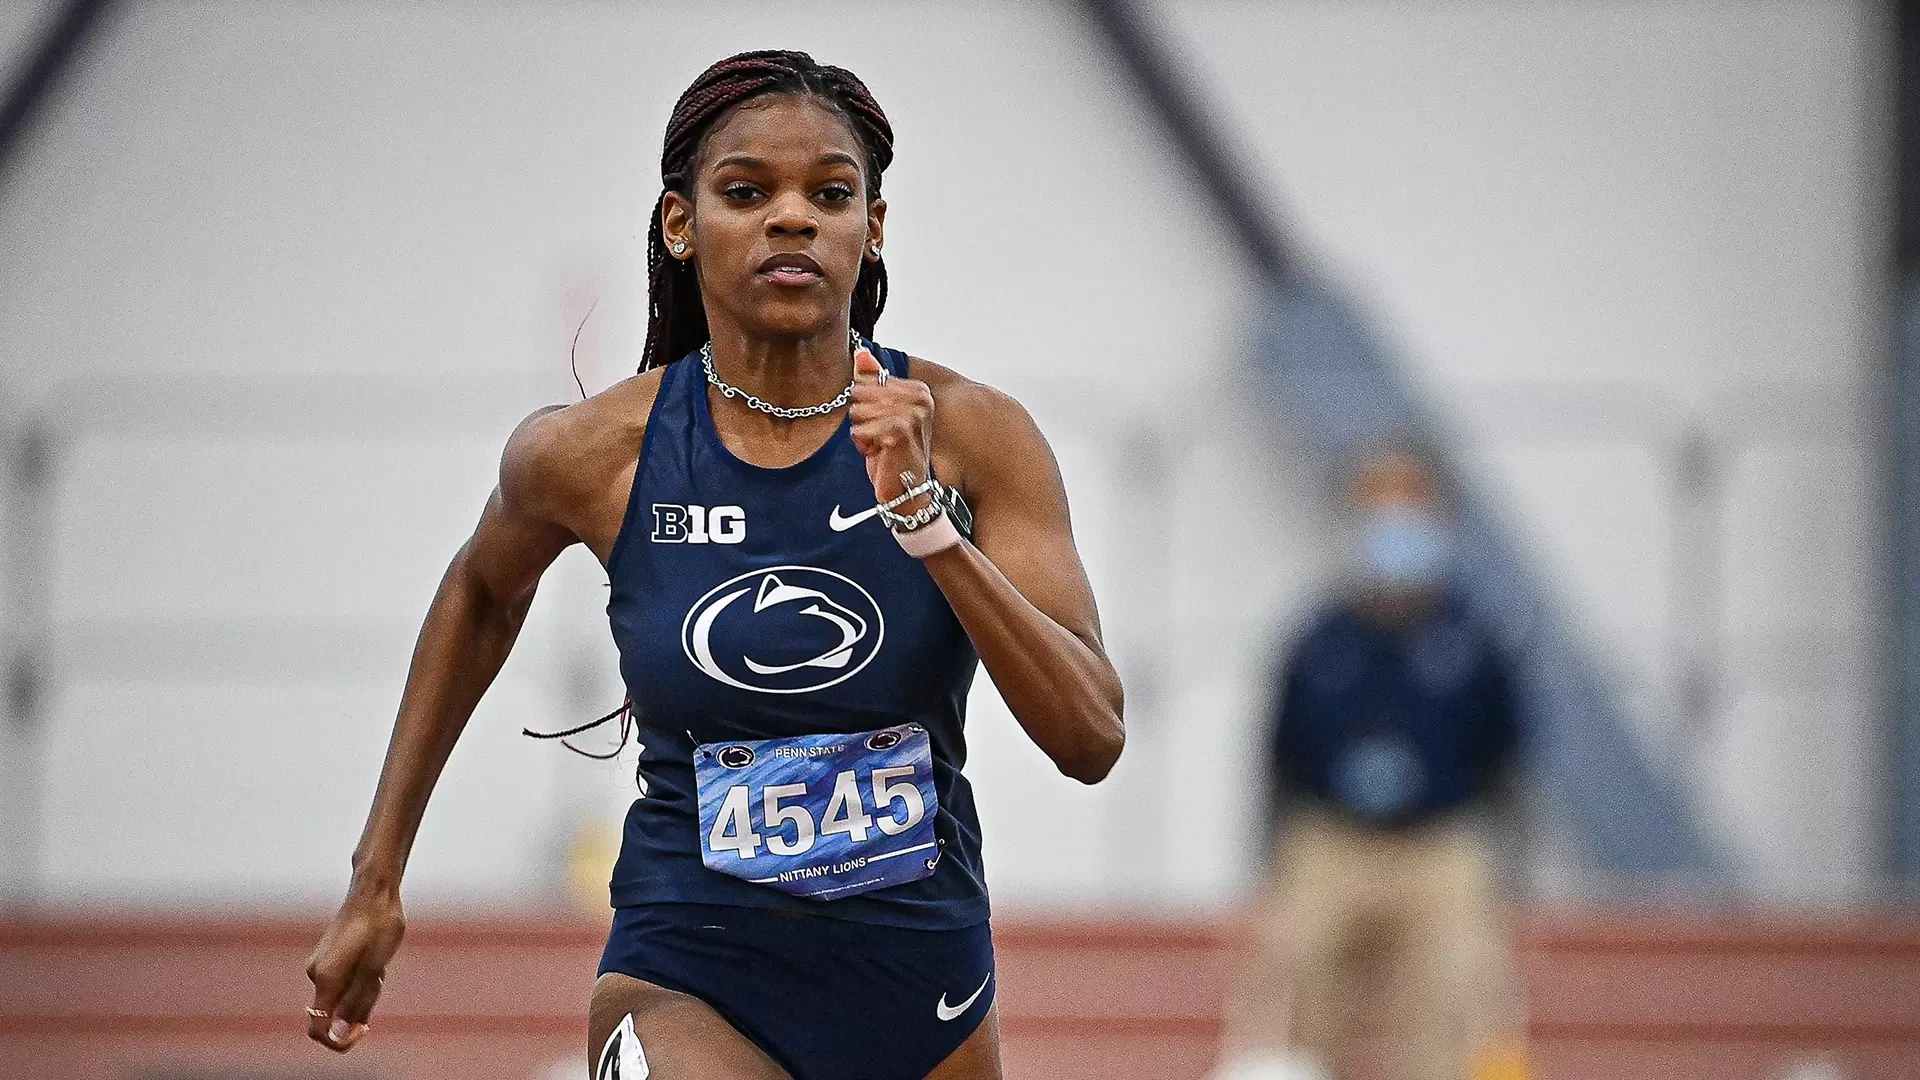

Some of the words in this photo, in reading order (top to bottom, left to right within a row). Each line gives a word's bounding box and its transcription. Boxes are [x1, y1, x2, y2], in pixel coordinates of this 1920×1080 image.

[775, 747, 807, 758] PENN
[808, 744, 845, 757] STATE
[708, 765, 925, 860] 4545
[779, 865, 830, 883] NITTANY
[832, 857, 867, 874] LIONS
